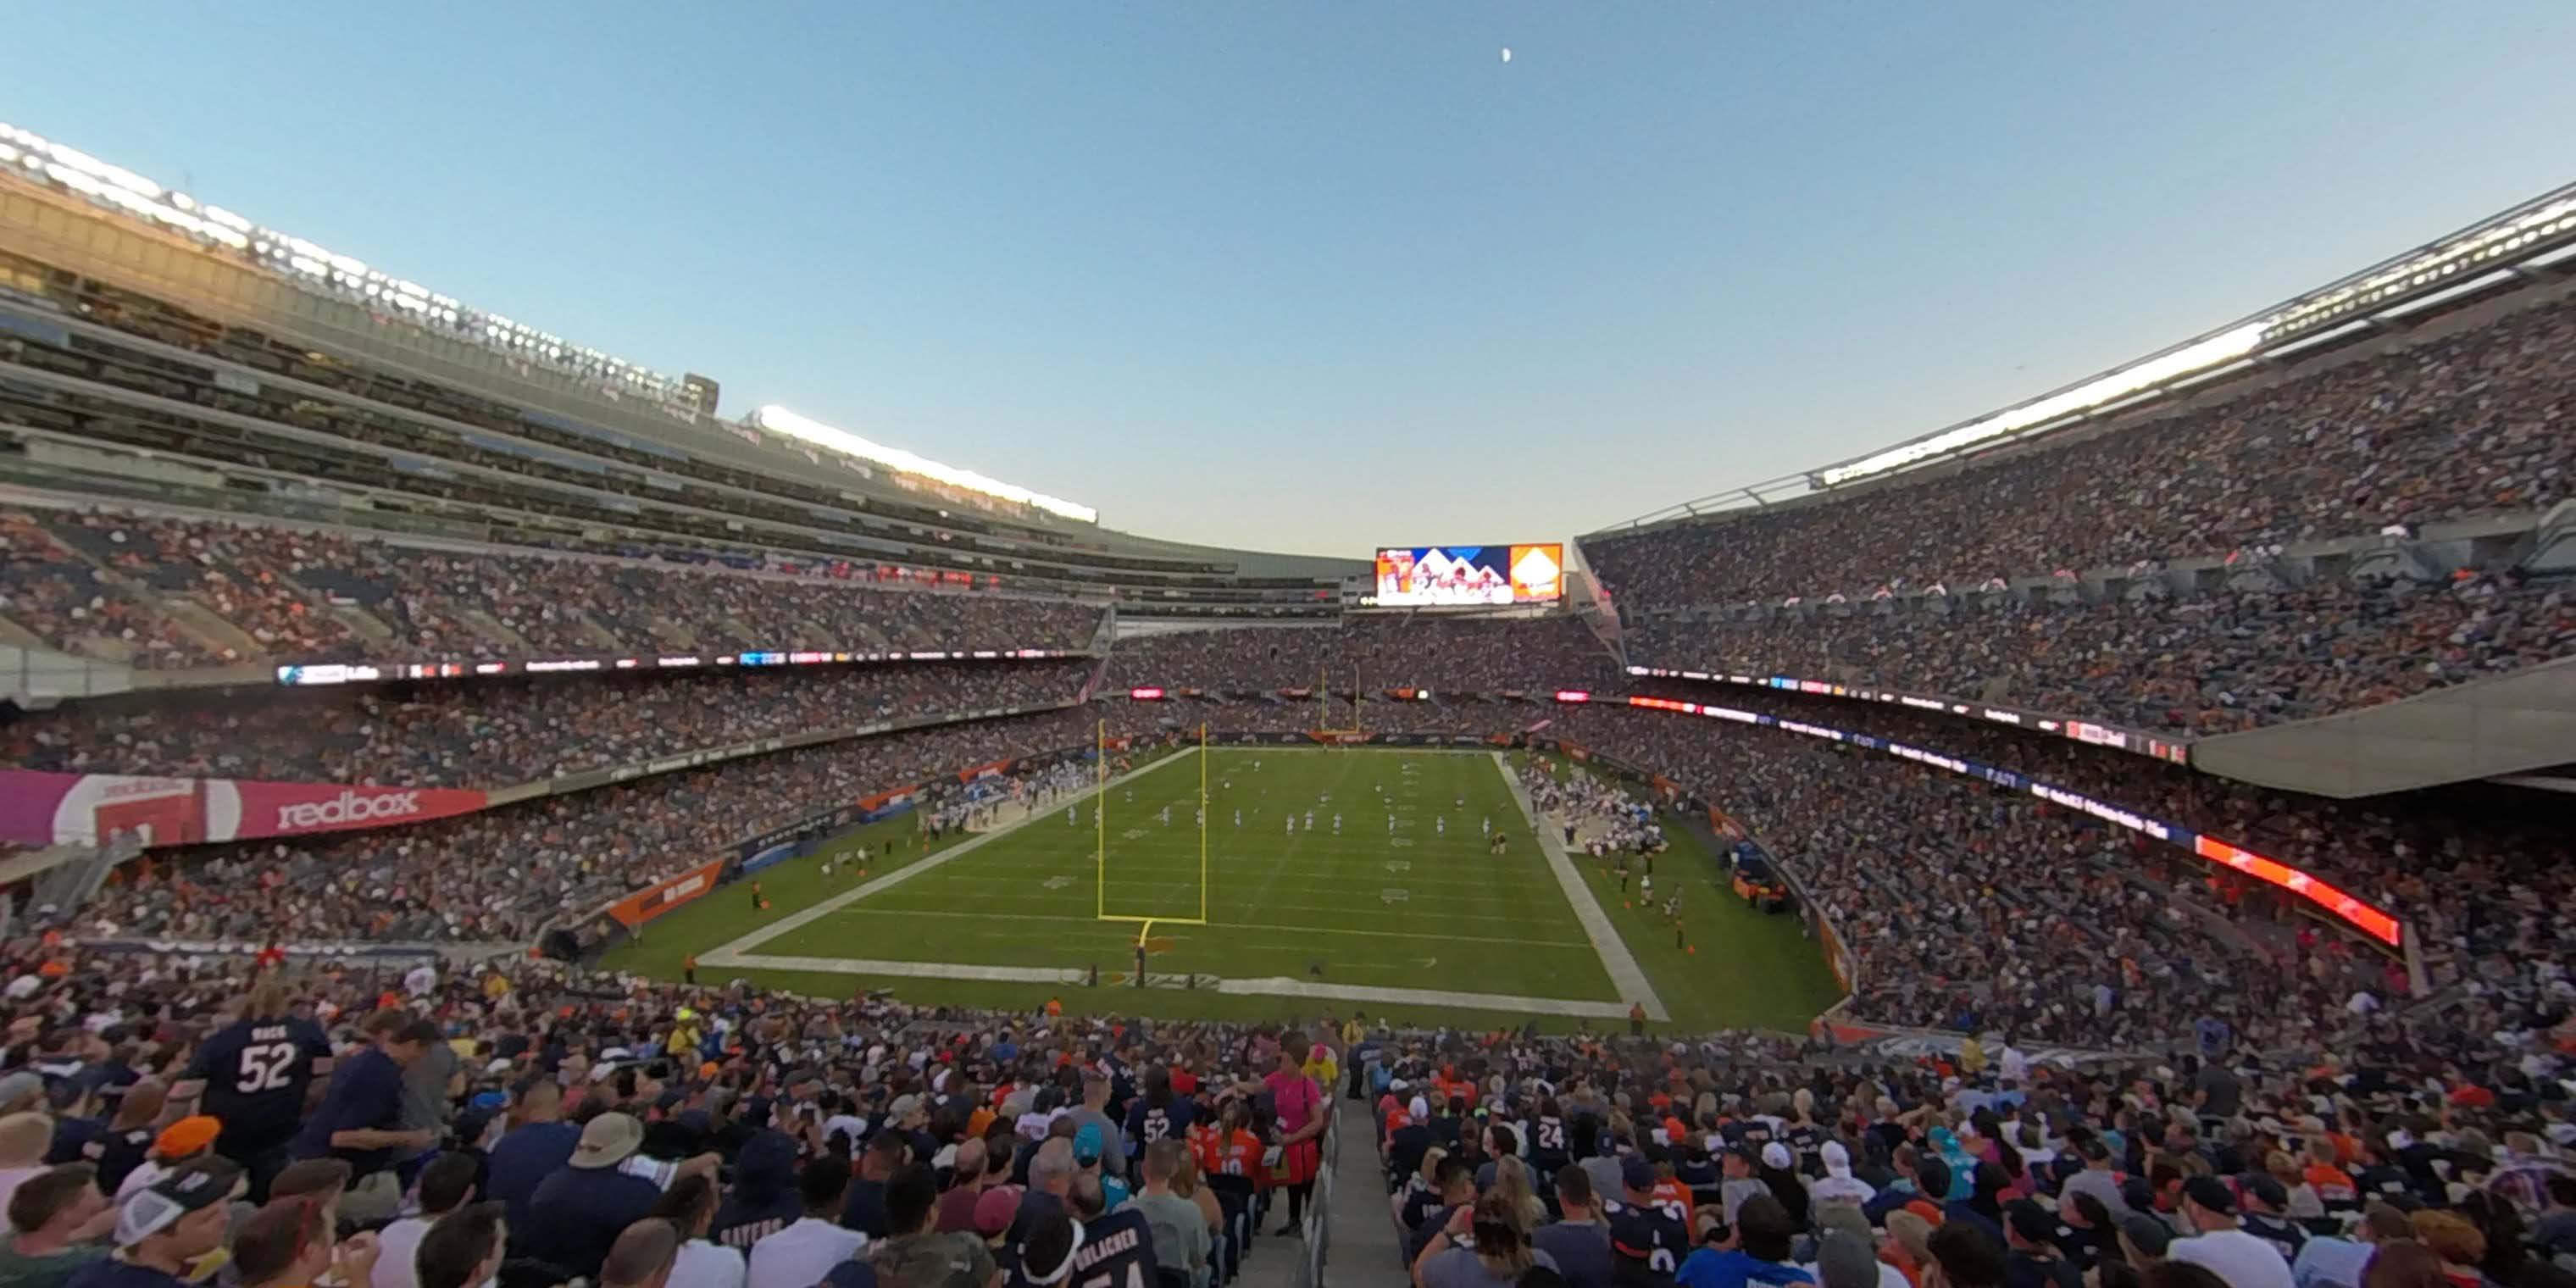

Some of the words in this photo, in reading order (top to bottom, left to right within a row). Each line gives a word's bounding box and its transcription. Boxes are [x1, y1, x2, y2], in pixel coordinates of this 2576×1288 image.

[278, 790, 419, 830] redbox
[236, 1042, 297, 1093] 52
[1144, 1117, 1170, 1144] 52
[1538, 1124, 1564, 1150] 24
[720, 1217, 785, 1246] SAYERS
